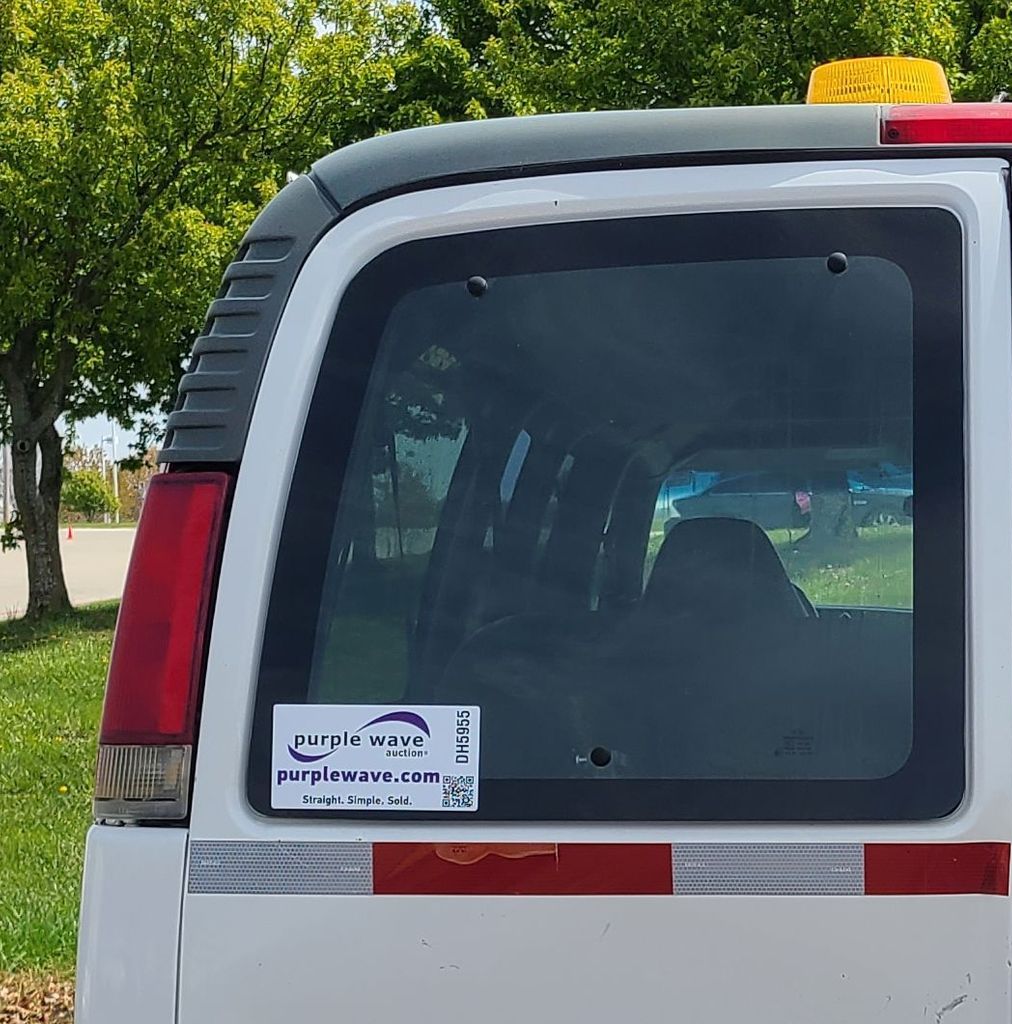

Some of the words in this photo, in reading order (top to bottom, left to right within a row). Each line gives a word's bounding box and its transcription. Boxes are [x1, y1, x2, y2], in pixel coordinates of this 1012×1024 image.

[294, 731, 361, 749] purple
[369, 734, 424, 747] wave
[456, 710, 470, 764] DH5955
[385, 749, 423, 758] auction
[277, 766, 440, 785] purplewave.com
[302, 795, 344, 805] Straight.
[347, 795, 384, 806] Simple.
[387, 796, 412, 806] Sold.
